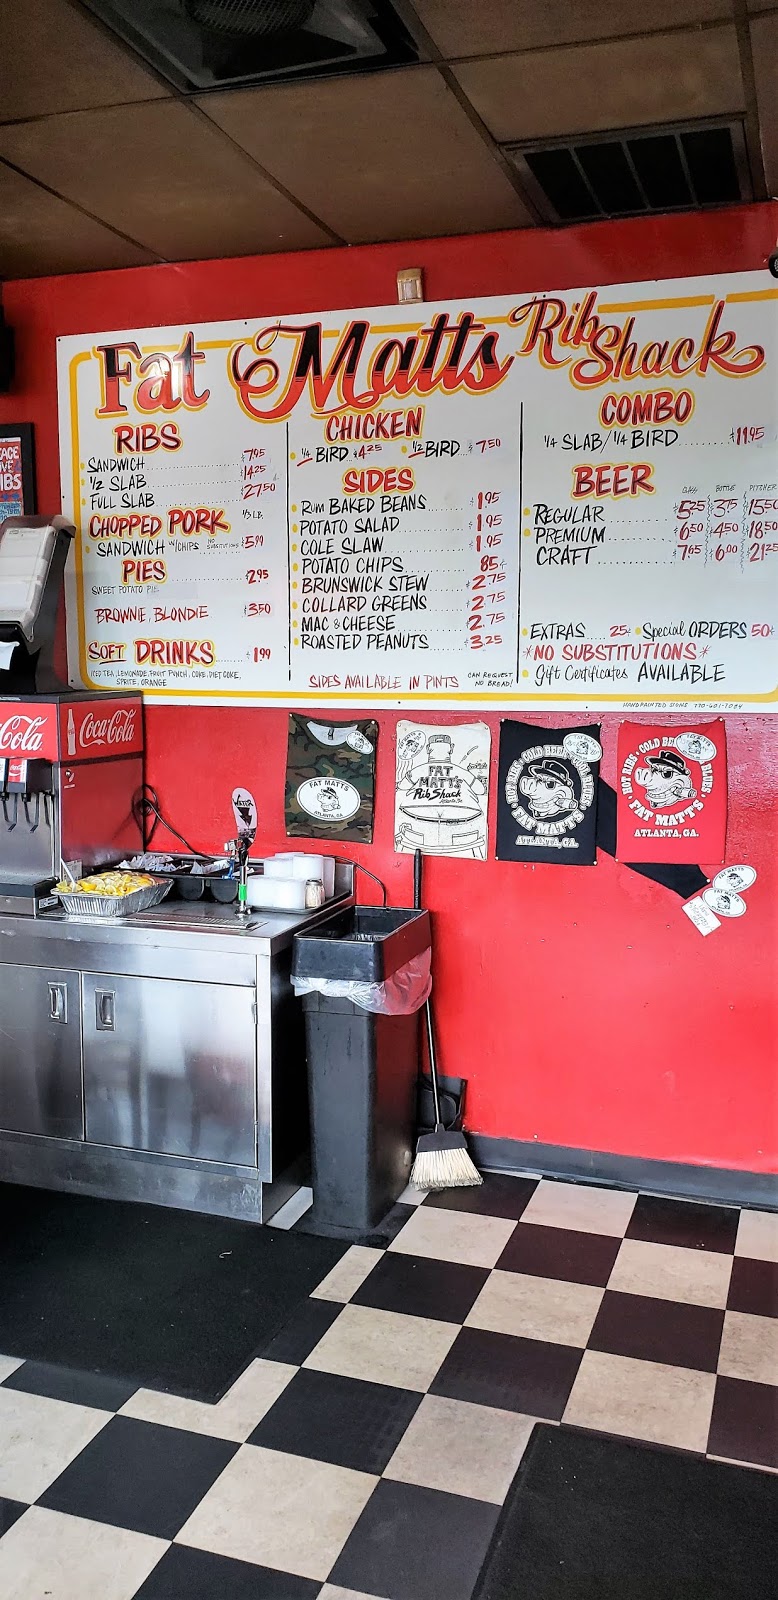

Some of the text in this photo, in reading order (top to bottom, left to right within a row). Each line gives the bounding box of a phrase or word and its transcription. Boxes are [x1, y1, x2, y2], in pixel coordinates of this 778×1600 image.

[96, 291, 765, 421] Fat Matts Rib Shack
[600, 389, 694, 429] COMBO
[325, 406, 425, 444] CHICKEN
[113, 423, 183, 453] RIBS
[631, 430, 679, 449] BIRD
[315, 447, 349, 463] BIRD
[424, 440, 461, 458] BIRD
[87, 457, 145, 473] SANDWICH
[108, 474, 147, 491] SLAB
[342, 467, 415, 494] SIDES
[571, 462, 656, 500] BEER
[90, 494, 118, 511] FULL
[120, 491, 155, 509] SLAB
[328, 498, 375, 516] BAKED
[380, 494, 427, 513] BEANS
[533, 503, 605, 525] REGULAR
[88, 513, 163, 540] CHOPPED
[167, 508, 231, 537] PORK
[299, 519, 348, 536] POTATO
[353, 517, 400, 533] SALAD
[533, 526, 606, 545] PREMIUM
[96, 539, 165, 558] SANDWICH
[300, 538, 334, 556] COLE
[341, 536, 384, 554] SLAW
[536, 545, 598, 566] CRAFT
[121, 560, 167, 584] PIES
[302, 557, 349, 574] POTATO
[356, 557, 404, 573] CHIPS
[92, 586, 115, 595] SWEET
[118, 586, 143, 594] POTATO
[301, 576, 383, 594] BRUNSWICK
[388, 574, 430, 592] STEW
[302, 596, 366, 613] COLLARD
[371, 594, 427, 611] GREENS
[154, 606, 209, 623] BLONDIE
[301, 615, 329, 632] MAC
[333, 617, 341, 629] &
[342, 615, 396, 631] CHEESE
[530, 623, 586, 640] EXTRAS
[642, 622, 686, 642] Special
[688, 621, 748, 639] ORDERS
[300, 633, 361, 650] ROASTED
[367, 633, 430, 651] PEANUTS
[88, 641, 126, 663] SOFT
[134, 638, 215, 667] DRINKS
[561, 642, 698, 662] SUBSTITUTIONS
[141, 679, 167, 687] ORANGE
[209, 670, 222, 679] DIET
[308, 673, 459, 690] SIDES AVAILABLE IN PINTS
[535, 661, 726, 687] Gift Certificates AVAILABLE
[639, 738, 660, 753] COLD
[428, 765, 453, 776] FAT
[506, 760, 523, 784] RIBS
[521, 746, 543, 763] COLD
[622, 754, 638, 775] RIBS
[309, 780, 350, 792] FAT MATTS
[419, 776, 463, 788] MATT'S
[621, 776, 633, 795] HOT
[701, 763, 713, 793] BLUES
[413, 788, 431, 800] Rib
[428, 788, 462, 801] Shack
[511, 806, 537, 831] FAT
[629, 799, 654, 821] FAT
[634, 829, 699, 838] ATLANTA, GA.
